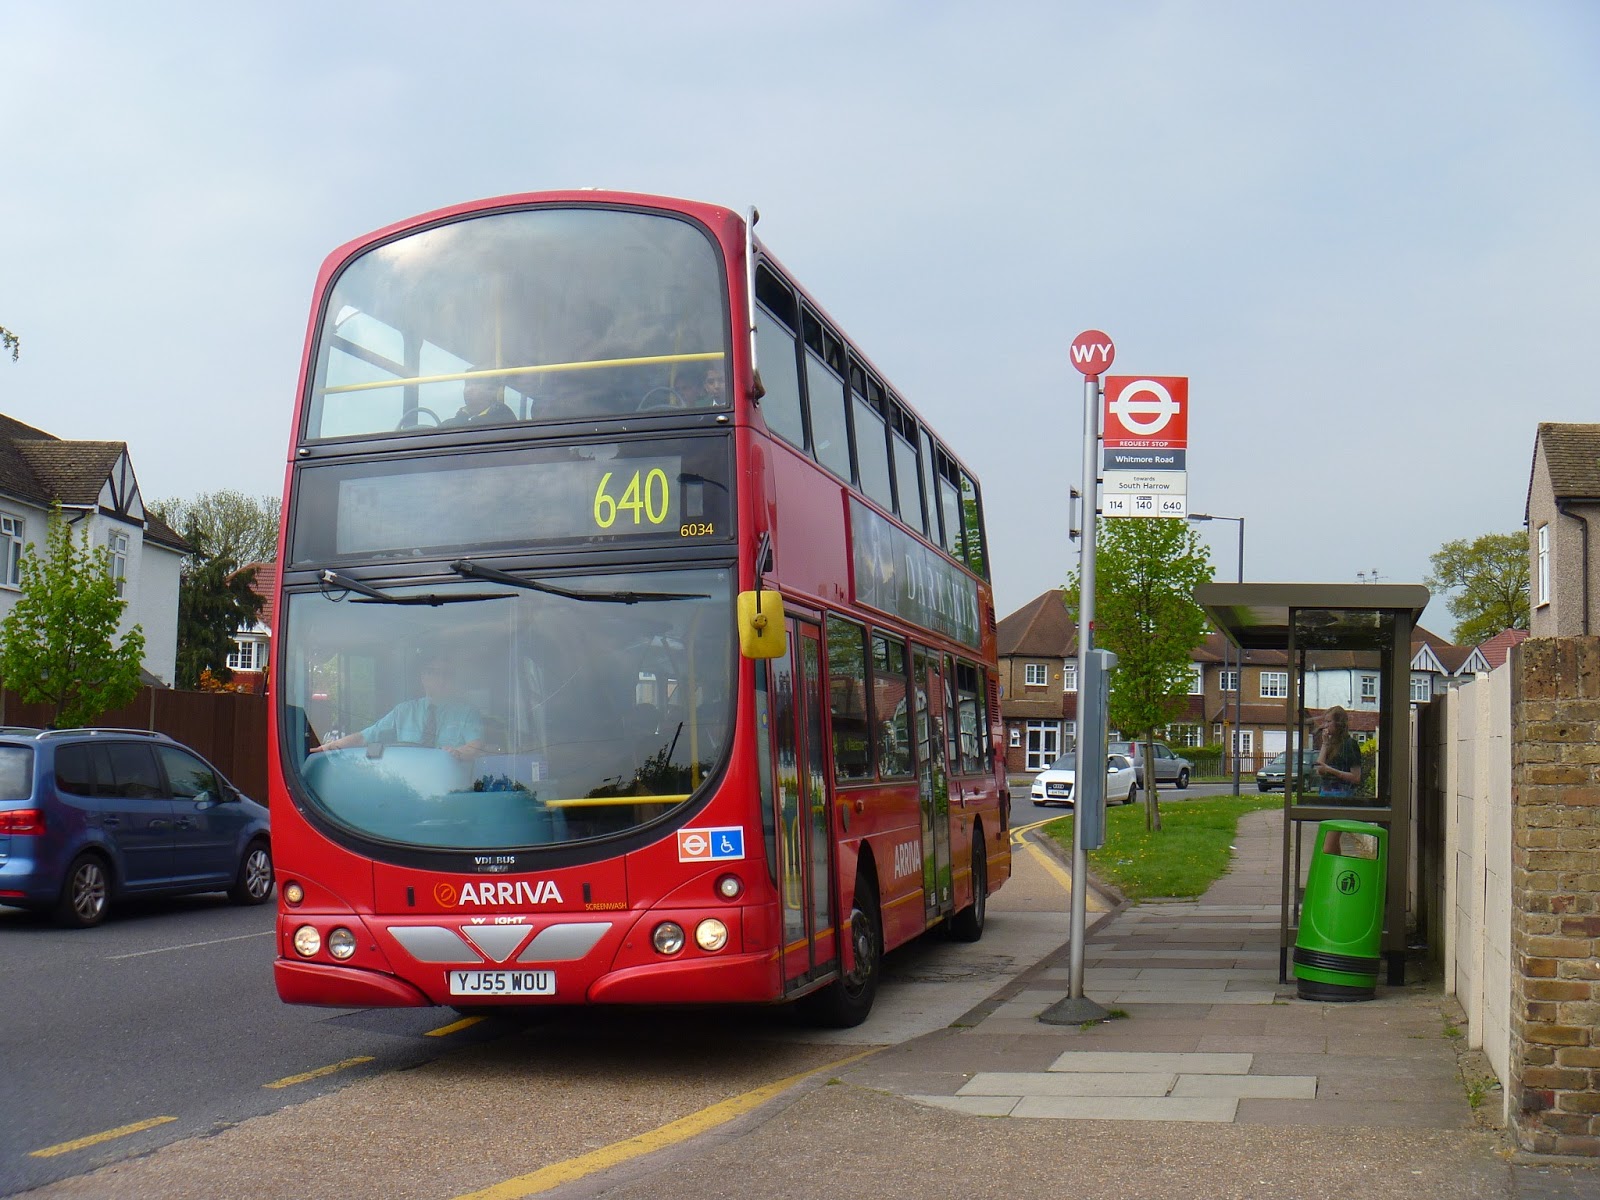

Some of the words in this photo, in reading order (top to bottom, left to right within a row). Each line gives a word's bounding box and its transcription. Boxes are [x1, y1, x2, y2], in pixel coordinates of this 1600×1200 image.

[1072, 343, 1112, 363] WY
[1115, 455, 1153, 463] Whitmore
[593, 467, 669, 529] 640
[1109, 501, 1123, 509] 114
[1136, 501, 1153, 510] 140
[1162, 501, 1182, 510] 640
[680, 523, 714, 537] 6034
[904, 554, 946, 615] DARK
[496, 856, 515, 865] BUS
[894, 839, 922, 880] ARRIVA
[458, 880, 564, 906] ARRIVA
[585, 901, 628, 911] SCREENWASH
[458, 973, 506, 991] YJ55
[511, 973, 547, 991] WOU
